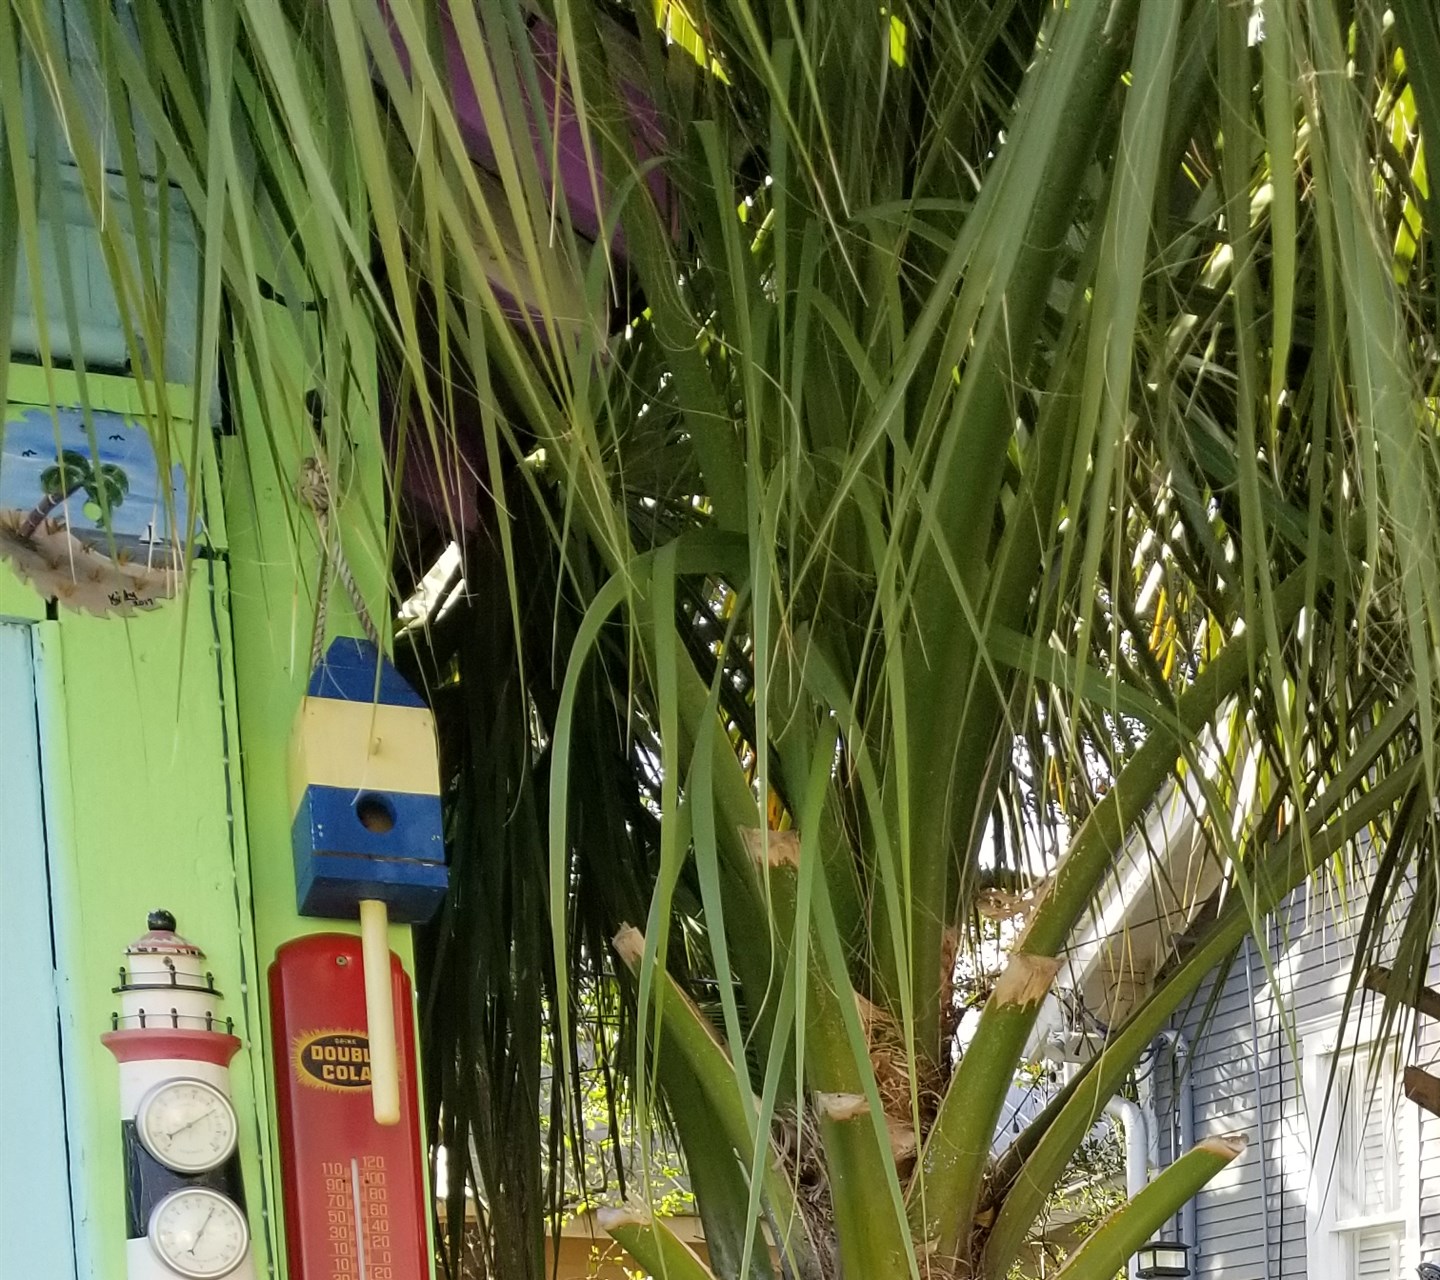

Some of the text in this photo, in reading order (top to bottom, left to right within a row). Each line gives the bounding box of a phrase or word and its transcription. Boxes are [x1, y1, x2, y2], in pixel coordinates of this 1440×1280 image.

[310, 1045, 371, 1062] DOUBL
[322, 1064, 372, 1081] COLA
[322, 1162, 343, 1175] 110
[363, 1156, 384, 1168] 120
[326, 1178, 344, 1191] 90
[369, 1187, 386, 1200] 80
[327, 1194, 345, 1207] 70
[370, 1203, 388, 1216] 60
[328, 1210, 346, 1223] 50
[371, 1219, 389, 1232] 40
[329, 1226, 347, 1239] 30
[372, 1235, 390, 1248] 20
[333, 1242, 348, 1255] 10
[383, 1251, 391, 1264] 0
[334, 1258, 349, 1271] 10
[374, 1266, 392, 1279] 20
